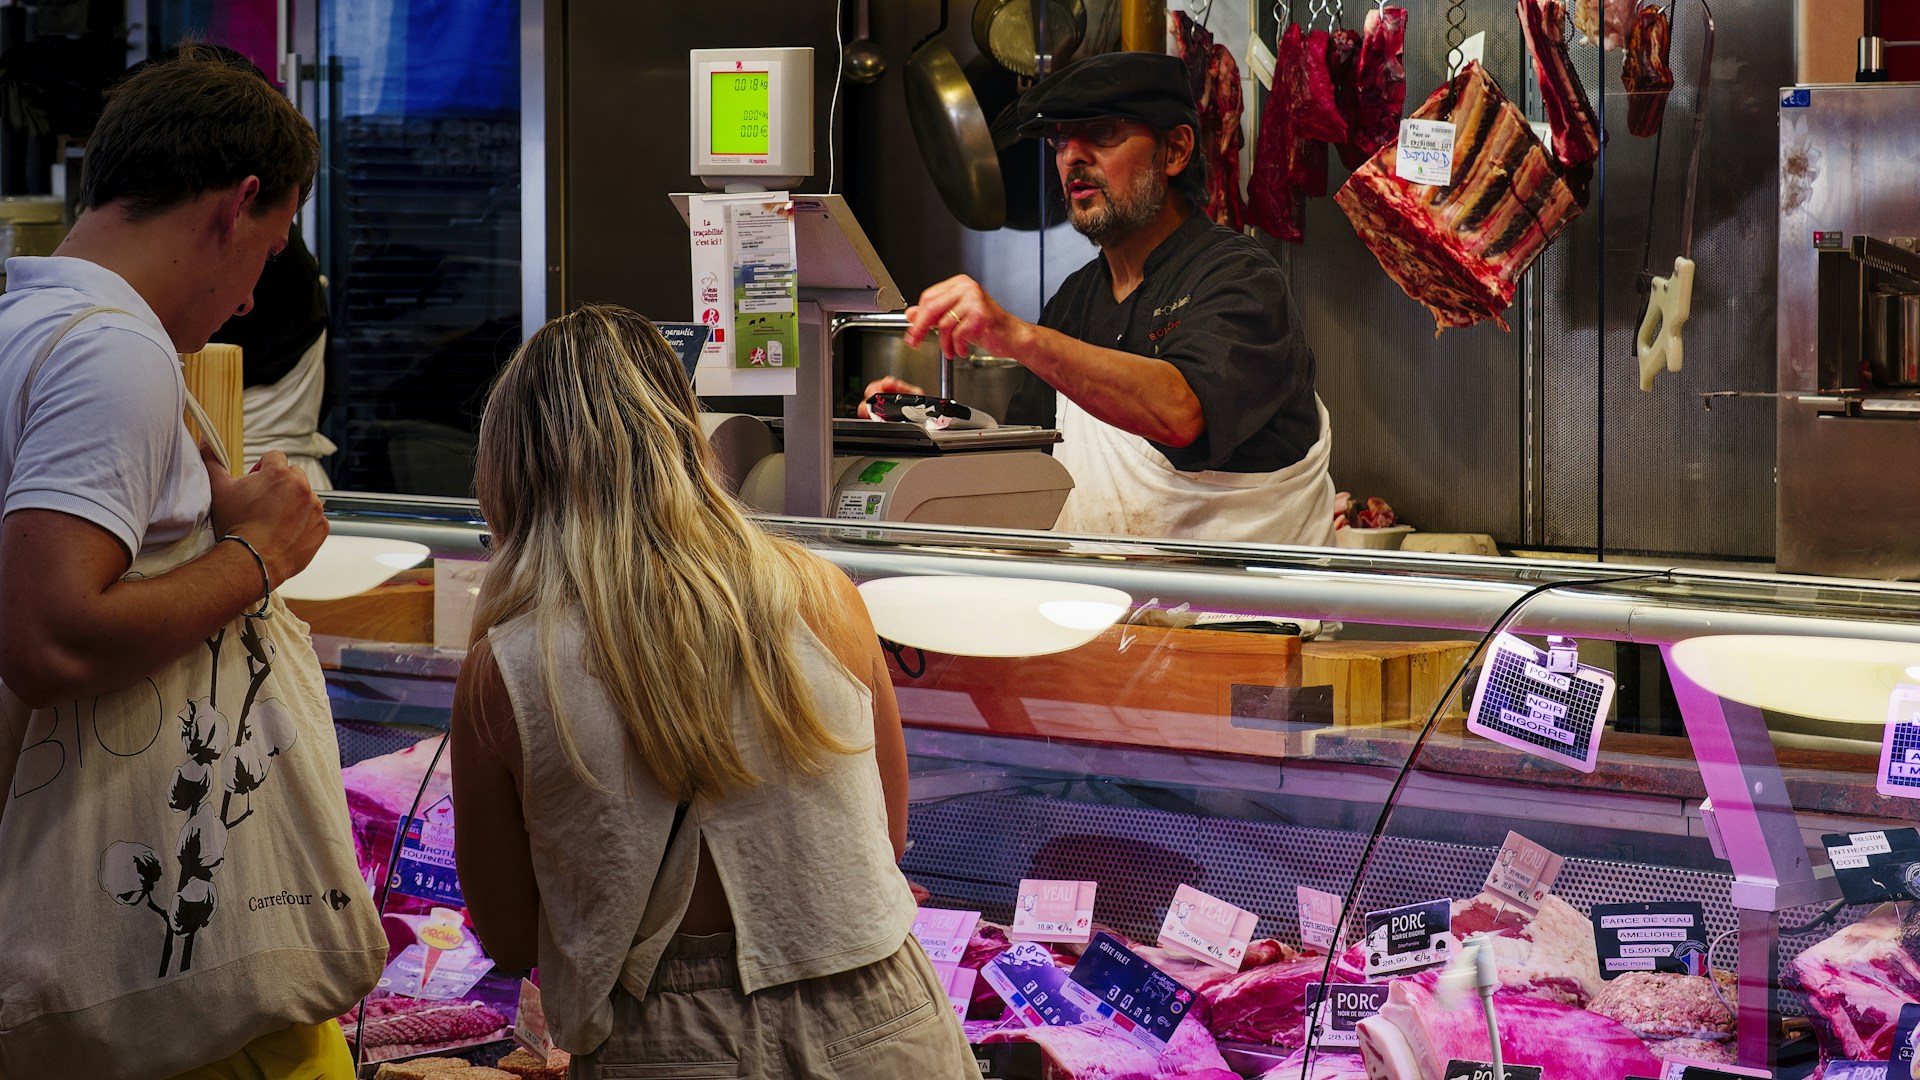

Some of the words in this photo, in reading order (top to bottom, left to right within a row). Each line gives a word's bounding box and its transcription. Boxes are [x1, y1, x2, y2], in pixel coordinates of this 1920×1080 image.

[693, 228, 724, 239] traçabilité
[695, 238, 710, 247] c'est
[710, 238, 718, 246] ici
[664, 325, 695, 341] garantie
[1529, 666, 1568, 687] PORC
[1528, 696, 1563, 715] NOIR
[1532, 710, 1553, 722] DE
[1503, 712, 1568, 741] BIGORRE
[1854, 834, 1884, 843] HOLSTEIN
[425, 846, 451, 857] ROTI
[1520, 845, 1545, 870] VEAU
[1829, 844, 1888, 856] ENTRECOTE
[1836, 858, 1863, 867] COTE
[1043, 885, 1074, 901] VEAU
[248, 890, 313, 912] Carrefour
[1199, 899, 1234, 925] VEAU
[931, 913, 960, 931] VEAU
[1057, 922, 1073, 934] €/kg
[1391, 911, 1426, 935] PORC
[1602, 917, 1640, 925] FARCE
[1661, 916, 1692, 924] VEAU
[421, 926, 461, 945] PROMO
[919, 938, 948, 947] GRENADIN
[1619, 931, 1686, 939] AMELIOREE
[1099, 941, 1114, 956] CÔTE
[1113, 951, 1131, 966] FILET
[1207, 945, 1223, 959] €/kg
[1382, 956, 1408, 967] 28.90
[1414, 952, 1431, 962] €/kg
[1337, 992, 1379, 1010] PORC
